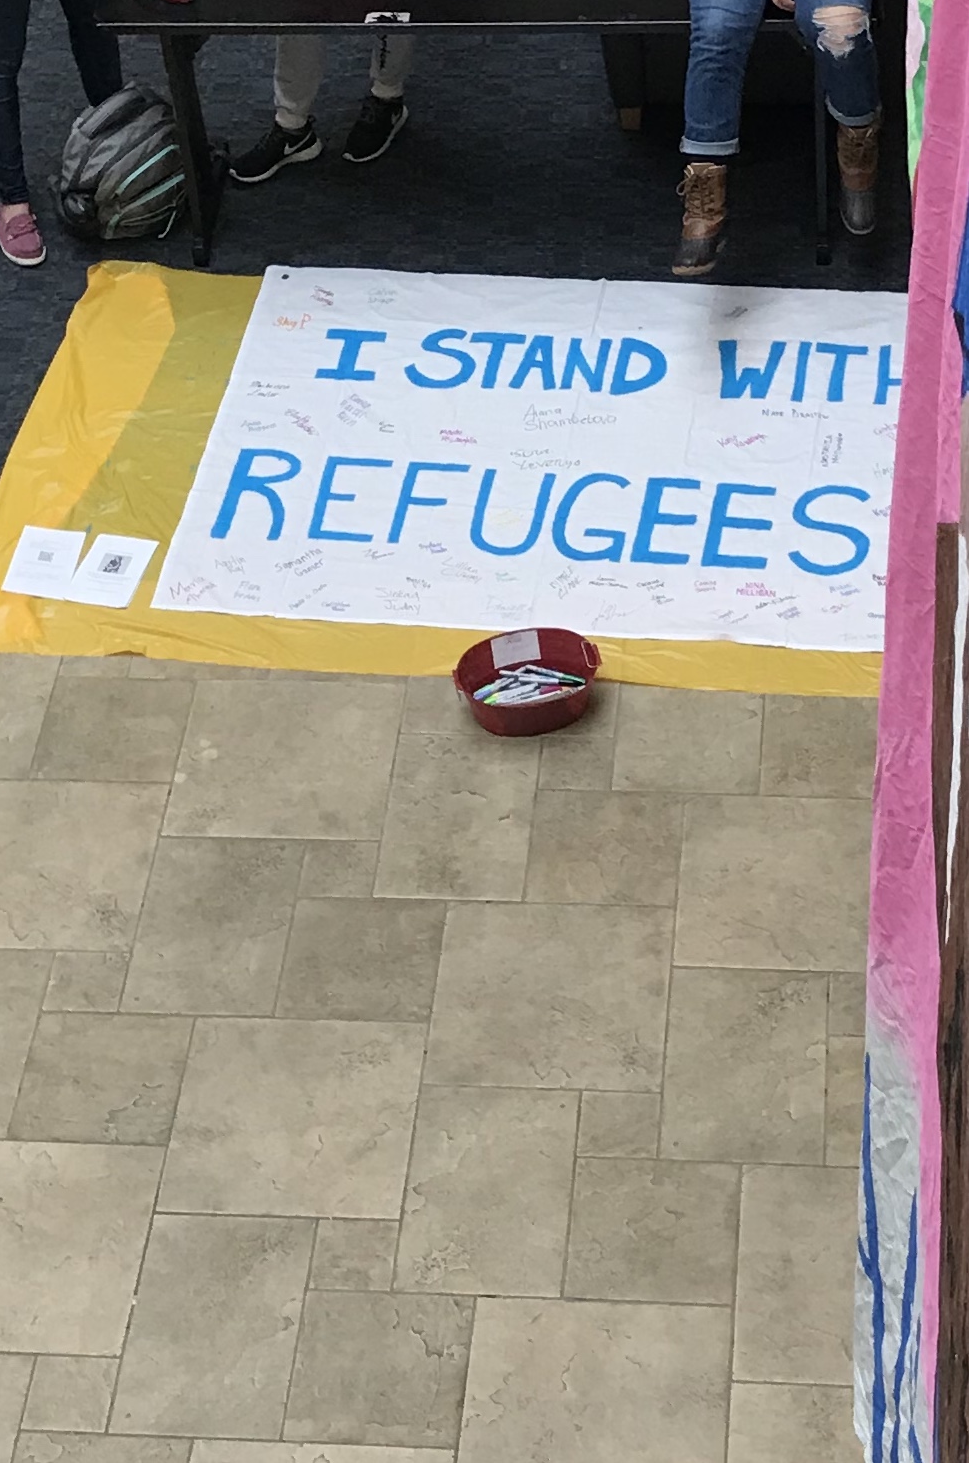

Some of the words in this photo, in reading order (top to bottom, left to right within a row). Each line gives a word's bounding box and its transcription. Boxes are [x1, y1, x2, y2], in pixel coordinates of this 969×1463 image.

[315, 328, 387, 381] I
[404, 328, 668, 396] STAND
[210, 448, 871, 576] REFUGEES
[274, 547, 324, 574] Samantha
[736, 588, 776, 598] MILLIGAN
